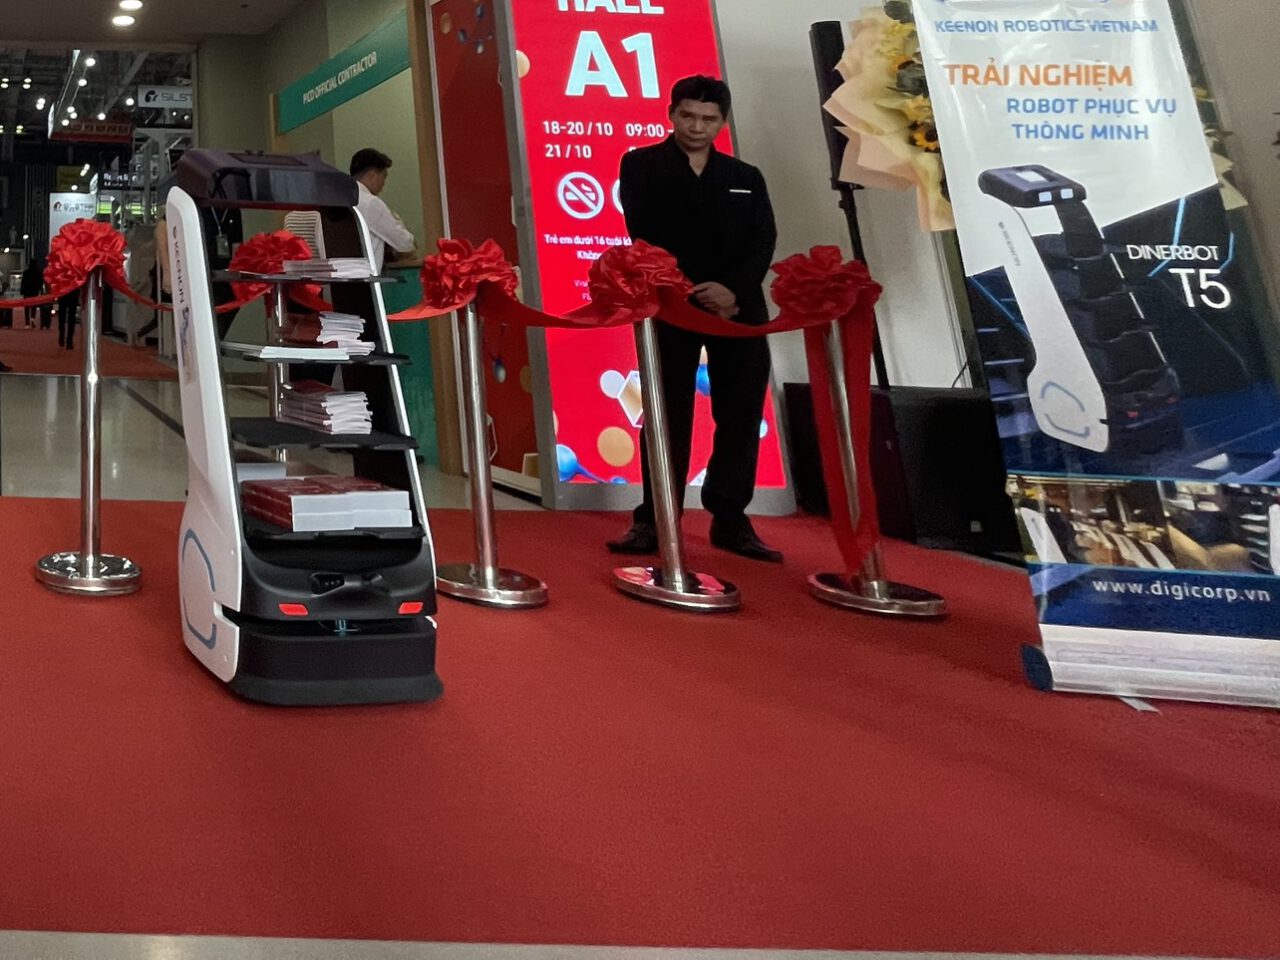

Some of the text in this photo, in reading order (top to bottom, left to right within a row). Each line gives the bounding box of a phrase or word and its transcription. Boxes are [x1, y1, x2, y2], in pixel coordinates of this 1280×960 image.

[935, 19, 1158, 34] KEENON ROBOTICS VIETNAM
[565, 30, 660, 98] A1
[943, 57, 1133, 91] TRẢI NGHIỆM
[1007, 98, 1176, 117] ROBOT PHỤC VỤ
[543, 121, 584, 136] 18-20
[596, 122, 613, 136] 10
[626, 123, 664, 138] 09:00
[1011, 121, 1149, 140] THÔNG MINH
[545, 145, 563, 158] 21
[575, 145, 592, 159] 10
[1126, 244, 1219, 261] DINERBOT
[1169, 268, 1231, 309] T5
[1092, 577, 1271, 603] www.digicorp.vn
